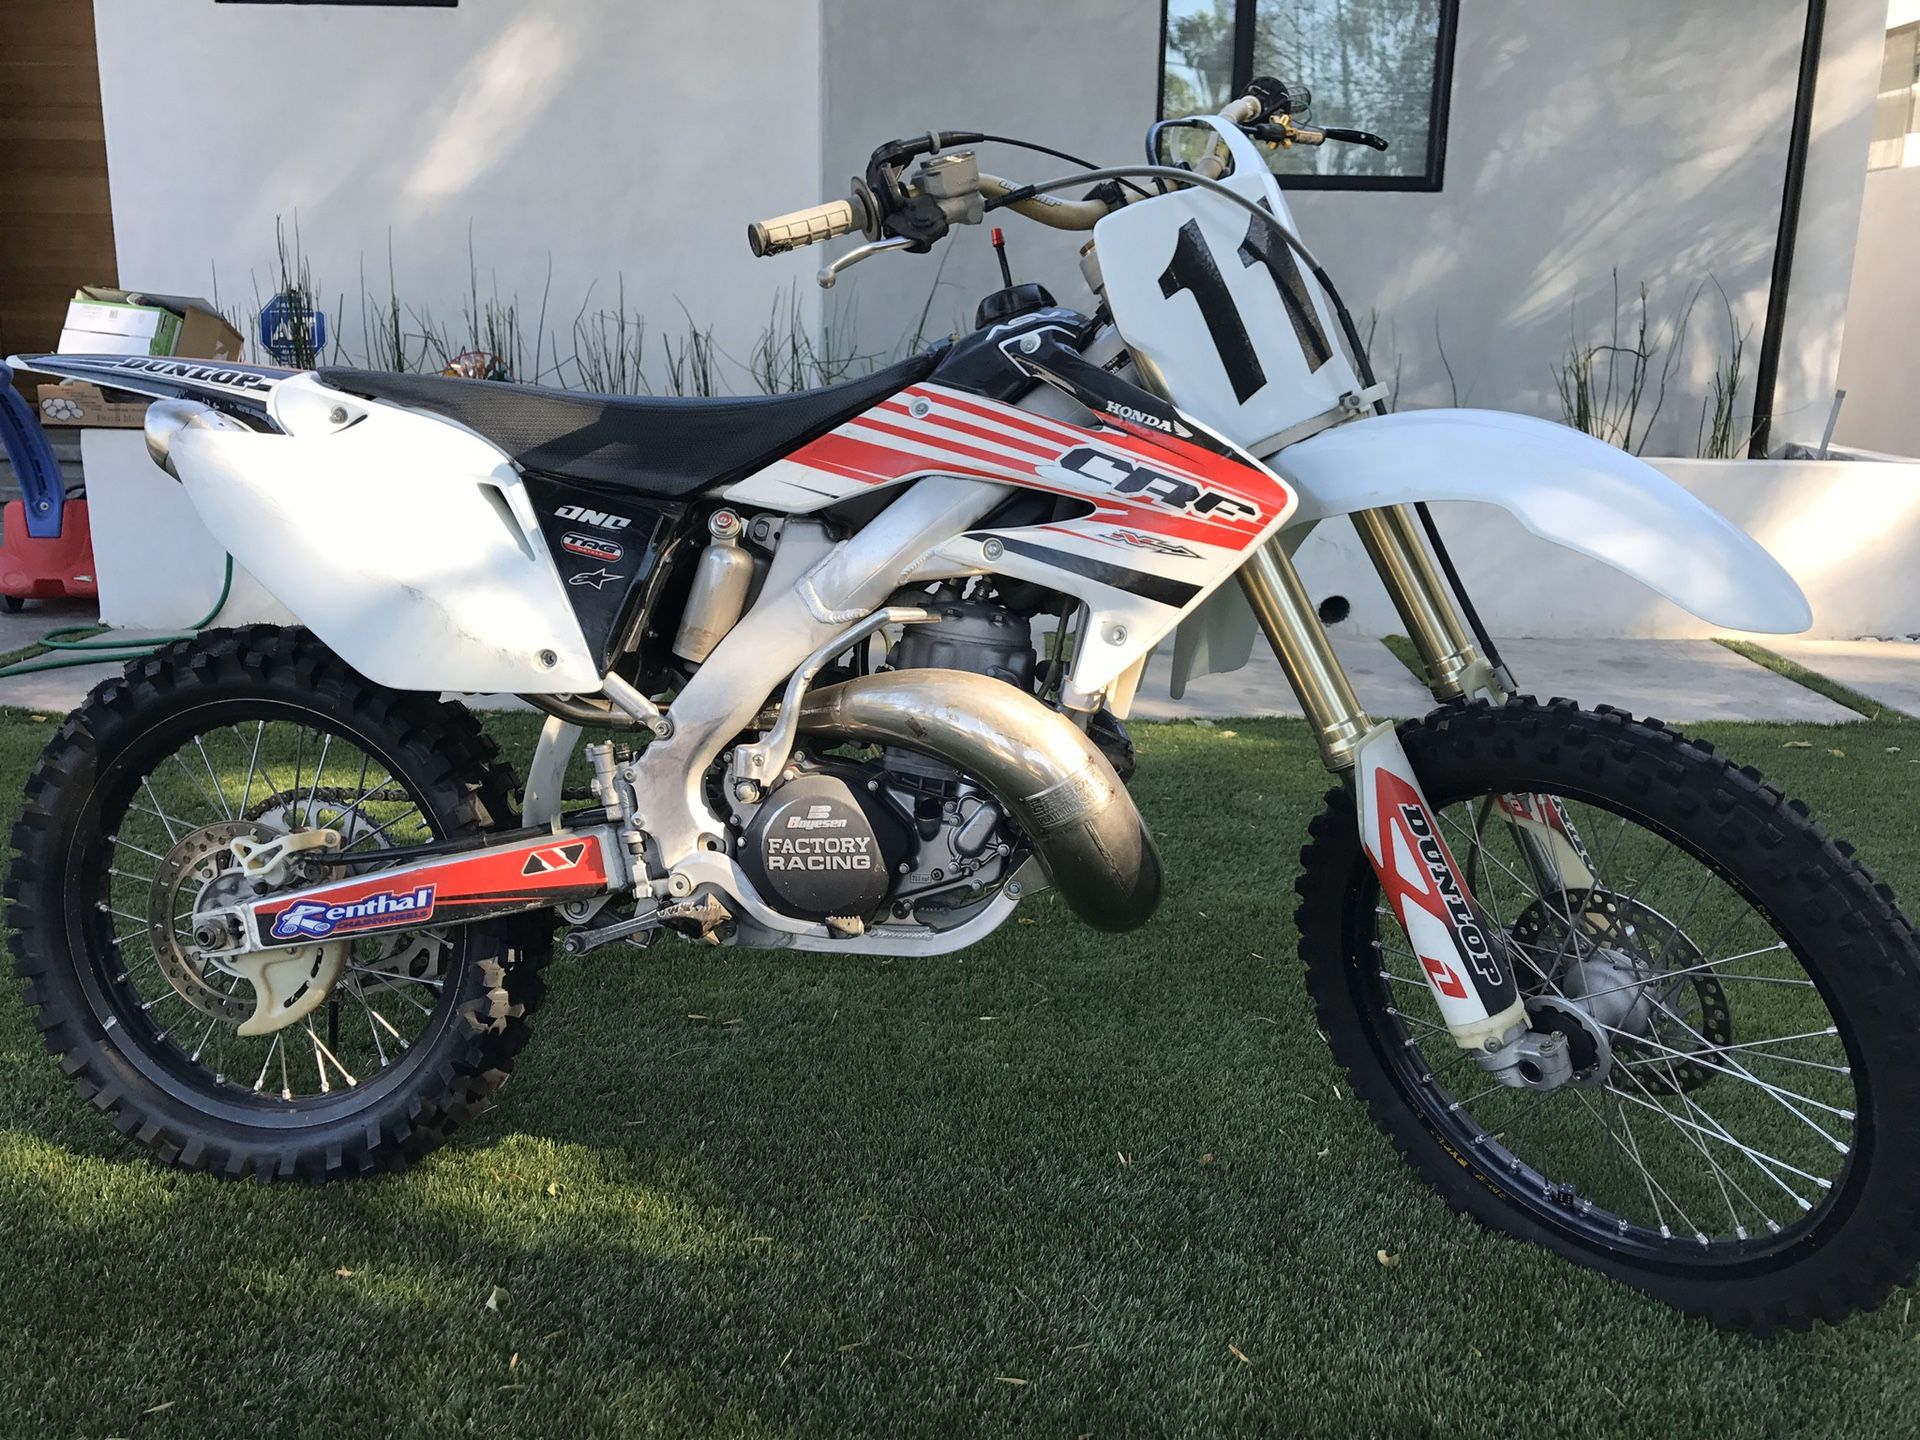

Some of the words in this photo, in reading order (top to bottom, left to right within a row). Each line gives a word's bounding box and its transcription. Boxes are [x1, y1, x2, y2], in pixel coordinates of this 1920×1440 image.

[1157, 195, 1334, 407] 11
[117, 357, 265, 387] DUNLOP
[1106, 400, 1173, 433] HONDA
[1059, 447, 1258, 517] CRF
[567, 535, 619, 554] TAG
[787, 815, 848, 830] Boyesen
[767, 836, 871, 854] FACTORY
[767, 855, 871, 871] RACING
[1398, 802, 1503, 986] DUNLOP
[281, 889, 429, 934] Renthal
